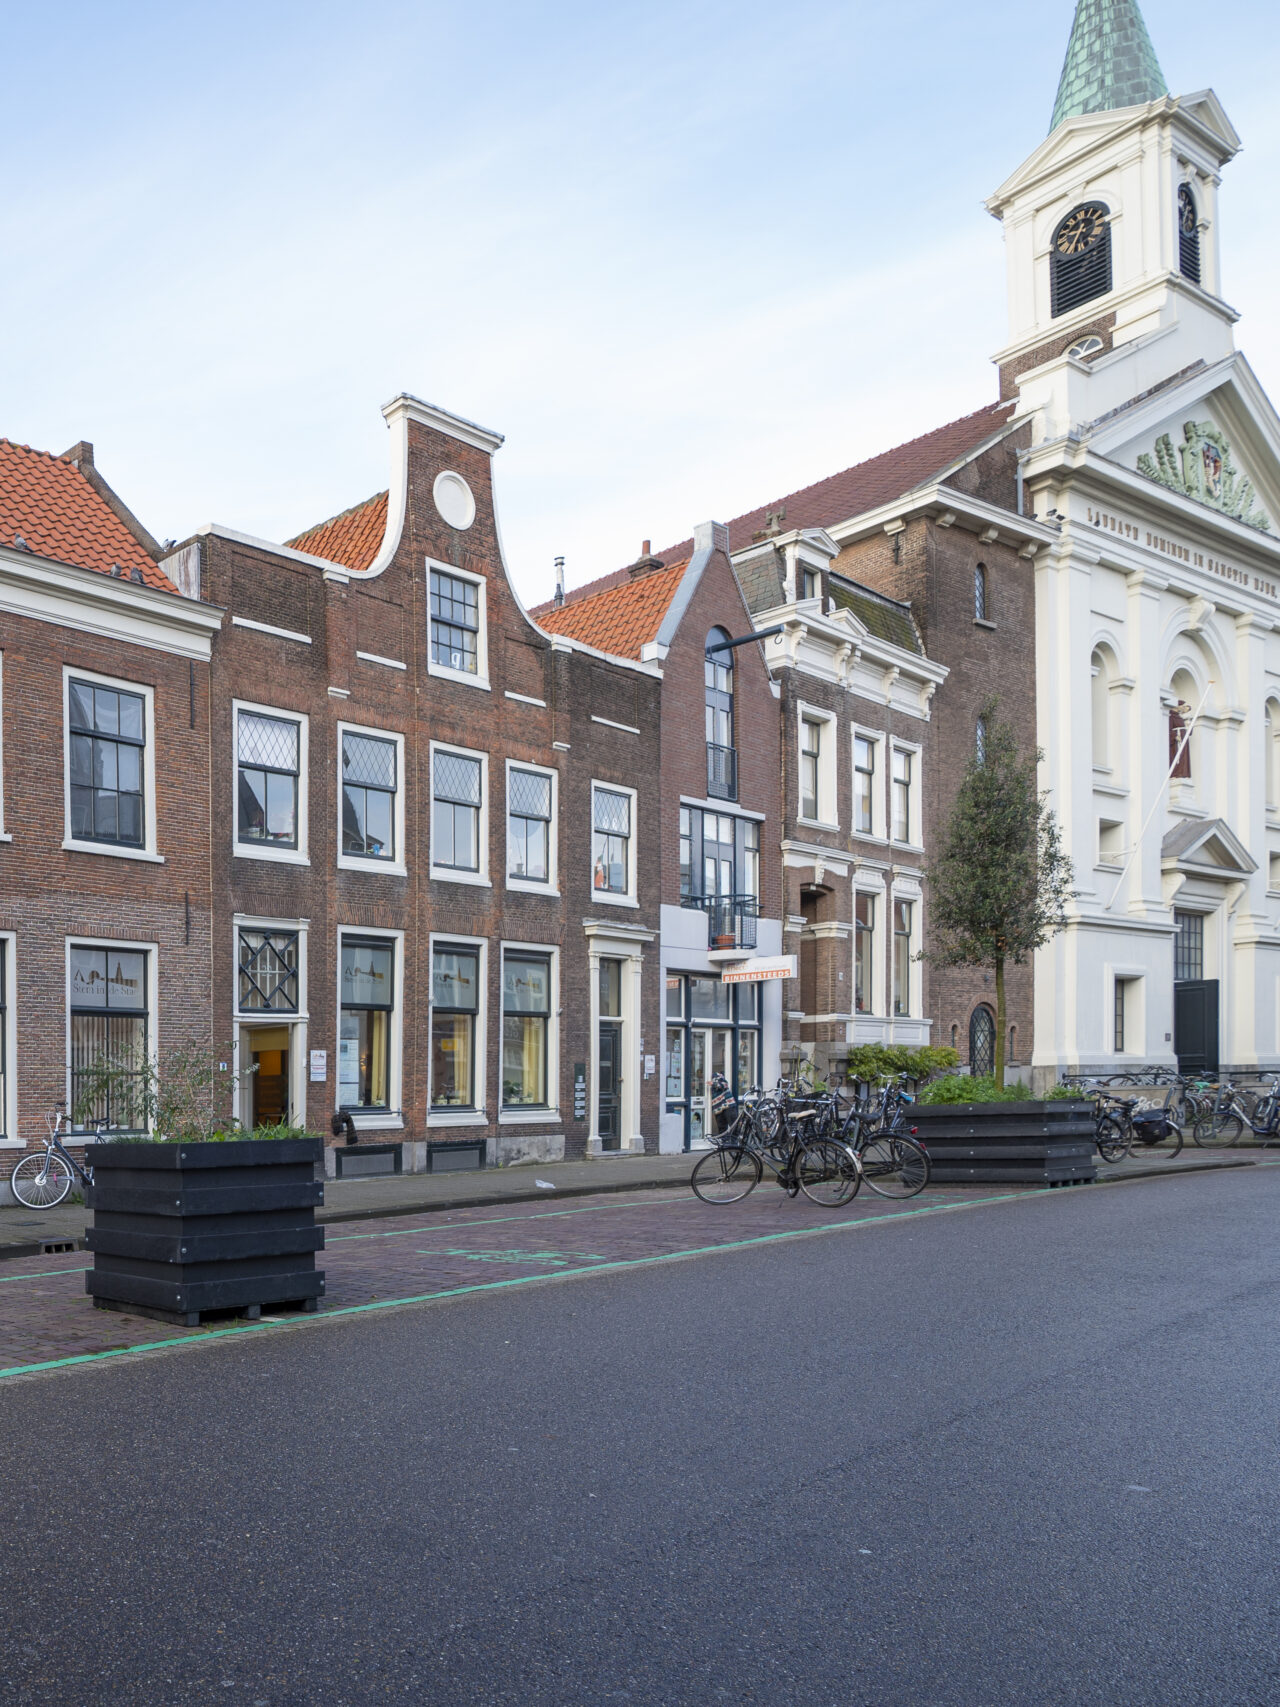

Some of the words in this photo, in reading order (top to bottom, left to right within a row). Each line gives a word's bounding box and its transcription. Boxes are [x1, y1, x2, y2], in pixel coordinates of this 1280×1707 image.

[1194, 552, 1204, 568] IN
[1208, 559, 1249, 586] SANCTIS
[724, 970, 790, 982] BINNENSTEEDS
[73, 984, 94, 995] Stem
[97, 985, 105, 995] in
